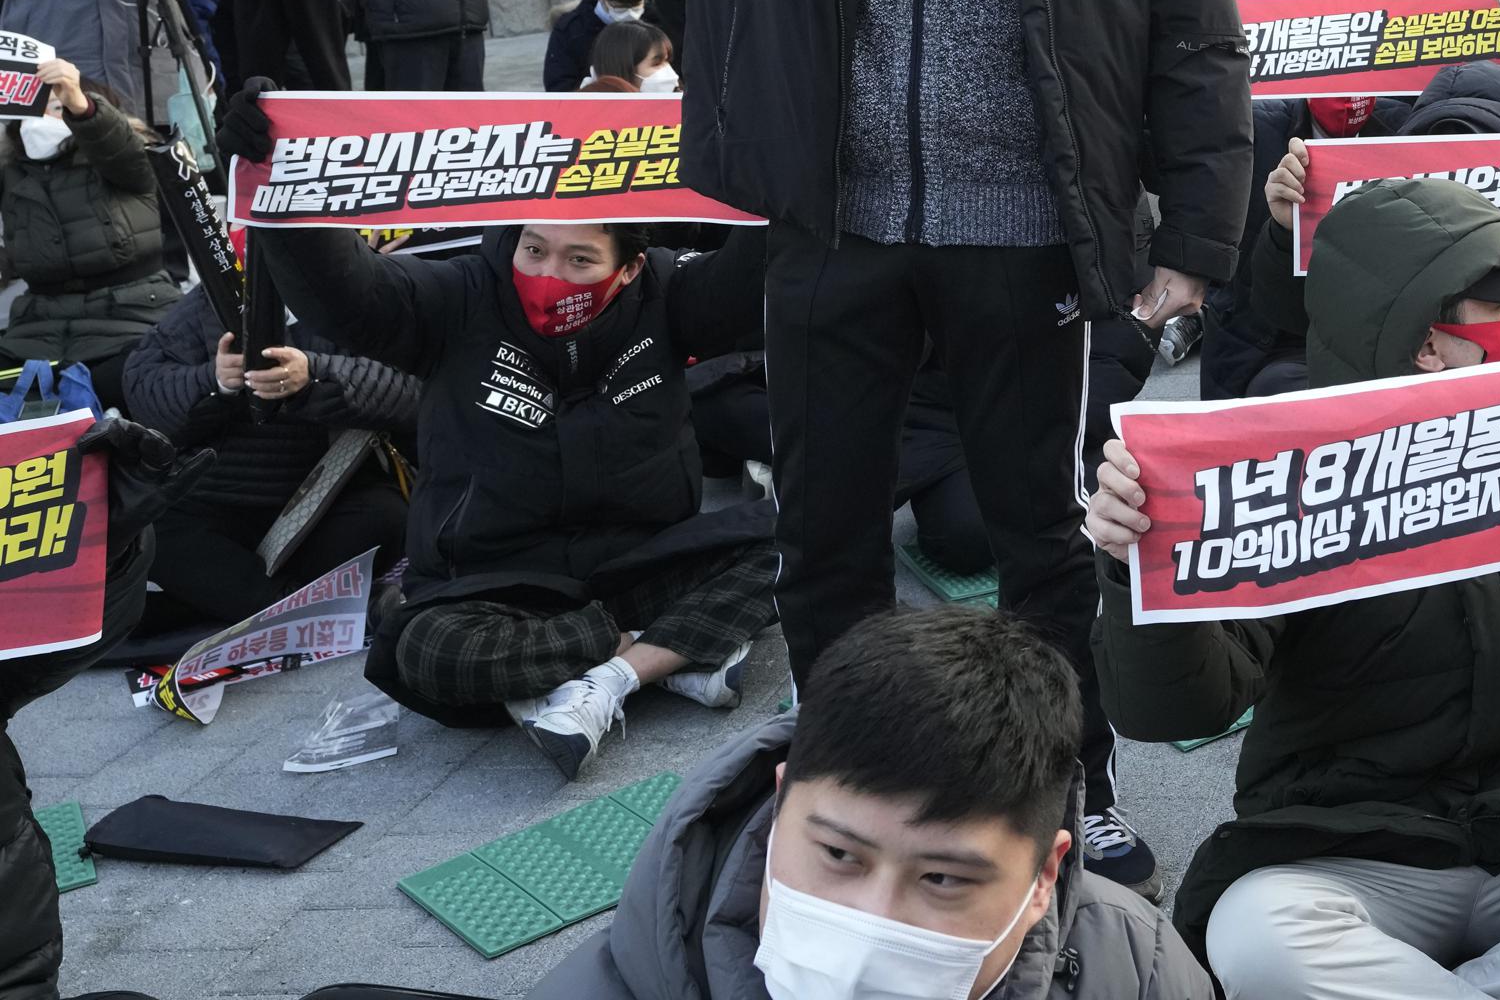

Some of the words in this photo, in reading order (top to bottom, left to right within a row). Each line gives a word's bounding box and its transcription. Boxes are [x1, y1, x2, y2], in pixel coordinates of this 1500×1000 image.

[1383, 12, 1470, 40] 손실보상
[1260, 45, 1369, 76] 자영업자도
[1374, 39, 1417, 65] 손실
[271, 120, 576, 181] 법인사업자는
[579, 124, 682, 161] 손실보
[252, 174, 402, 215] 매출규모
[405, 165, 553, 202] 상관없이
[555, 160, 630, 192] 손실
[1057, 308, 1081, 327] adidas
[490, 369, 543, 401] helvetia
[612, 374, 663, 406] DESCENTE
[501, 396, 547, 427] BKW
[1195, 448, 1299, 532] 1년
[1172, 511, 1358, 584] 10억이상
